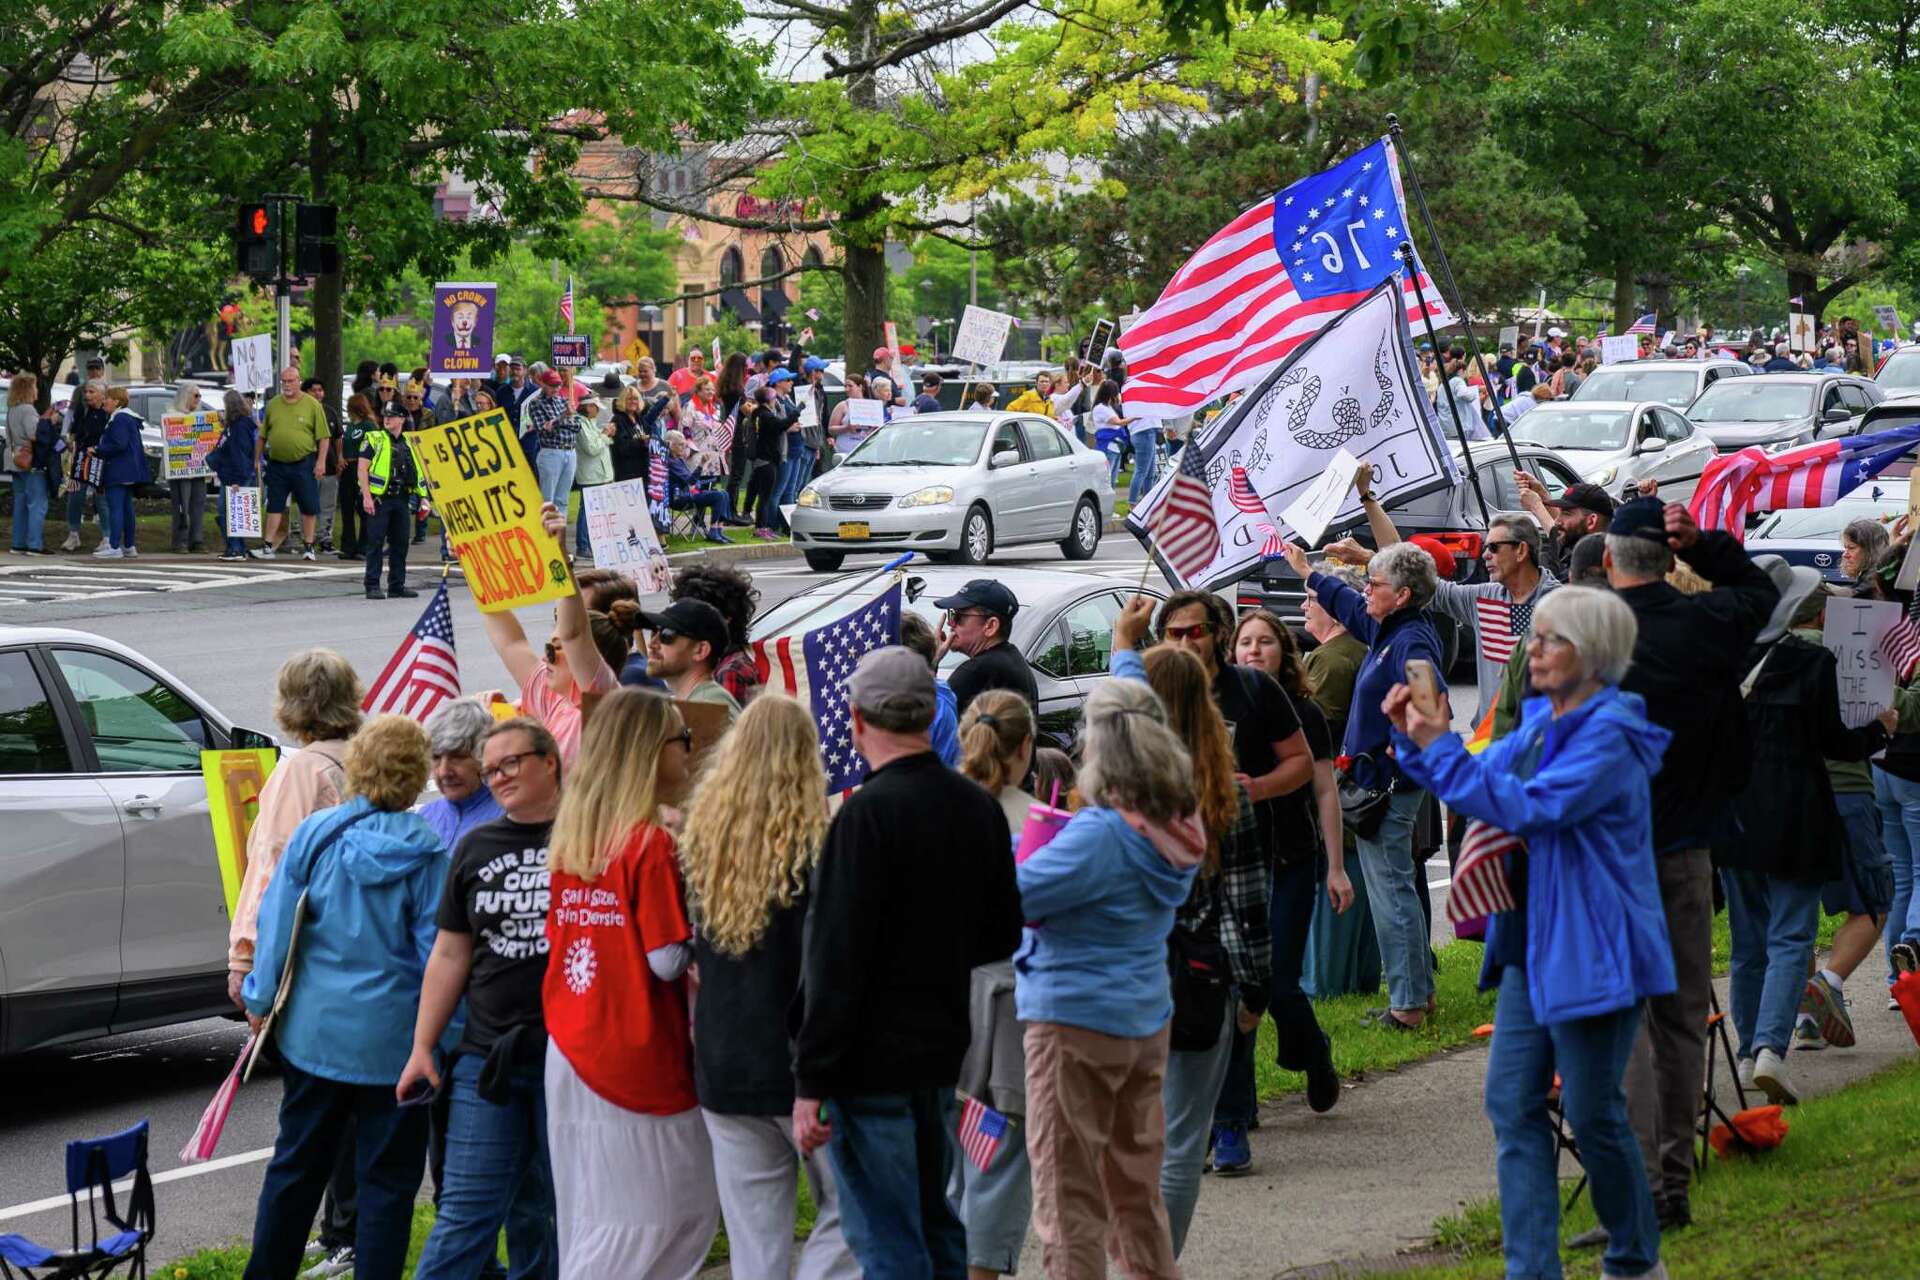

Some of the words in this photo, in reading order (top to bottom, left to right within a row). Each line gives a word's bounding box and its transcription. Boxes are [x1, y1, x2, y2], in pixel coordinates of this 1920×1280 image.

[443, 294, 457, 308] NO
[237, 341, 256, 366] NO
[443, 357, 480, 370] CLOWN
[554, 355, 586, 365] TRUMP
[433, 443, 450, 463] IS
[444, 414, 517, 481] BEST
[443, 494, 486, 536] WHEN
[483, 480, 526, 525] IT'S
[1851, 604, 1873, 636] I
[1840, 676, 1868, 695] THE
[478, 852, 519, 883] OUR
[503, 872, 552, 891] OUR
[475, 890, 552, 914] FUTUR
[500, 919, 547, 938] OUR
